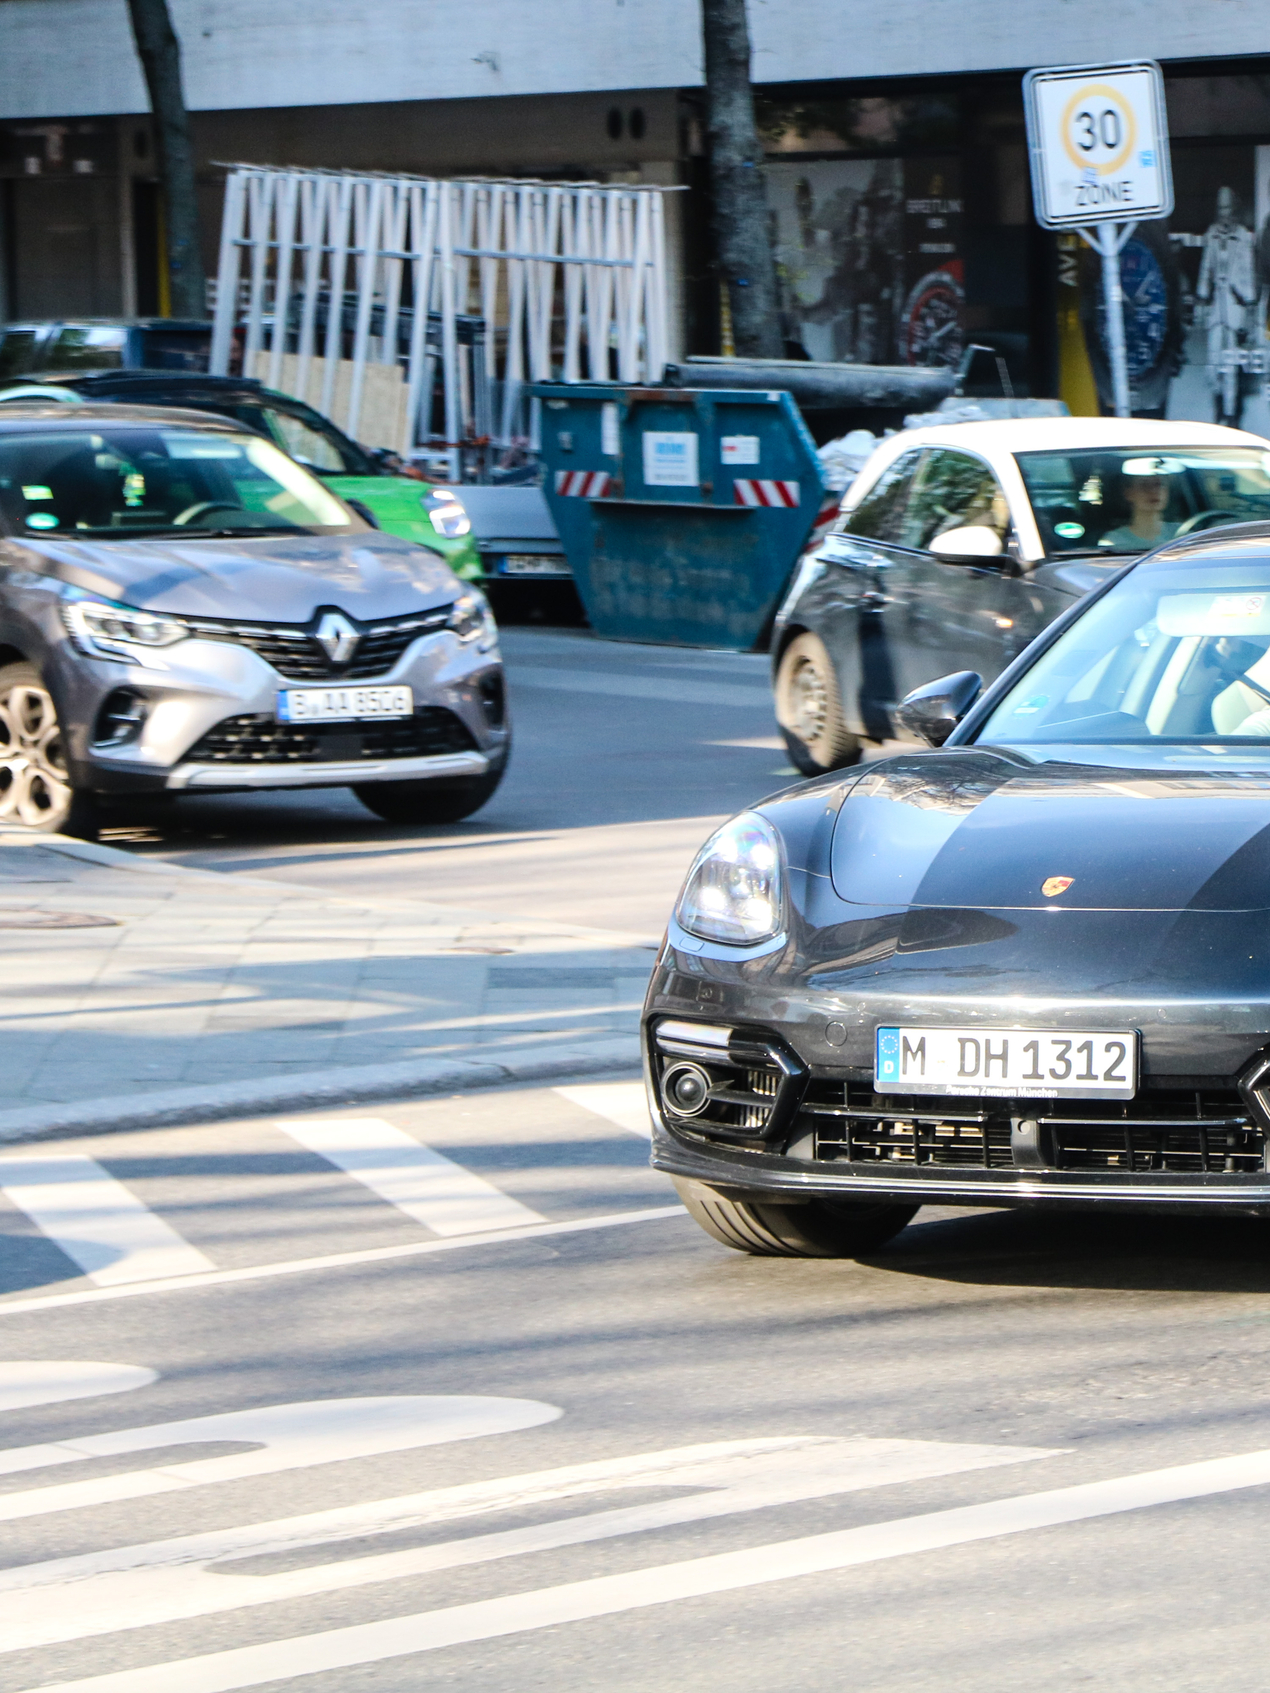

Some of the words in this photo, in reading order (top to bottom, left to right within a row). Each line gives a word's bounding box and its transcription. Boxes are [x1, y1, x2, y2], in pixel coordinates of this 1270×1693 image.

[1075, 109, 1122, 151] 30
[1075, 180, 1133, 207] ZONE
[883, 1060, 894, 1074] D
[902, 1035, 926, 1076] M
[957, 1037, 1009, 1079] DH
[1022, 1039, 1127, 1082] 1312
